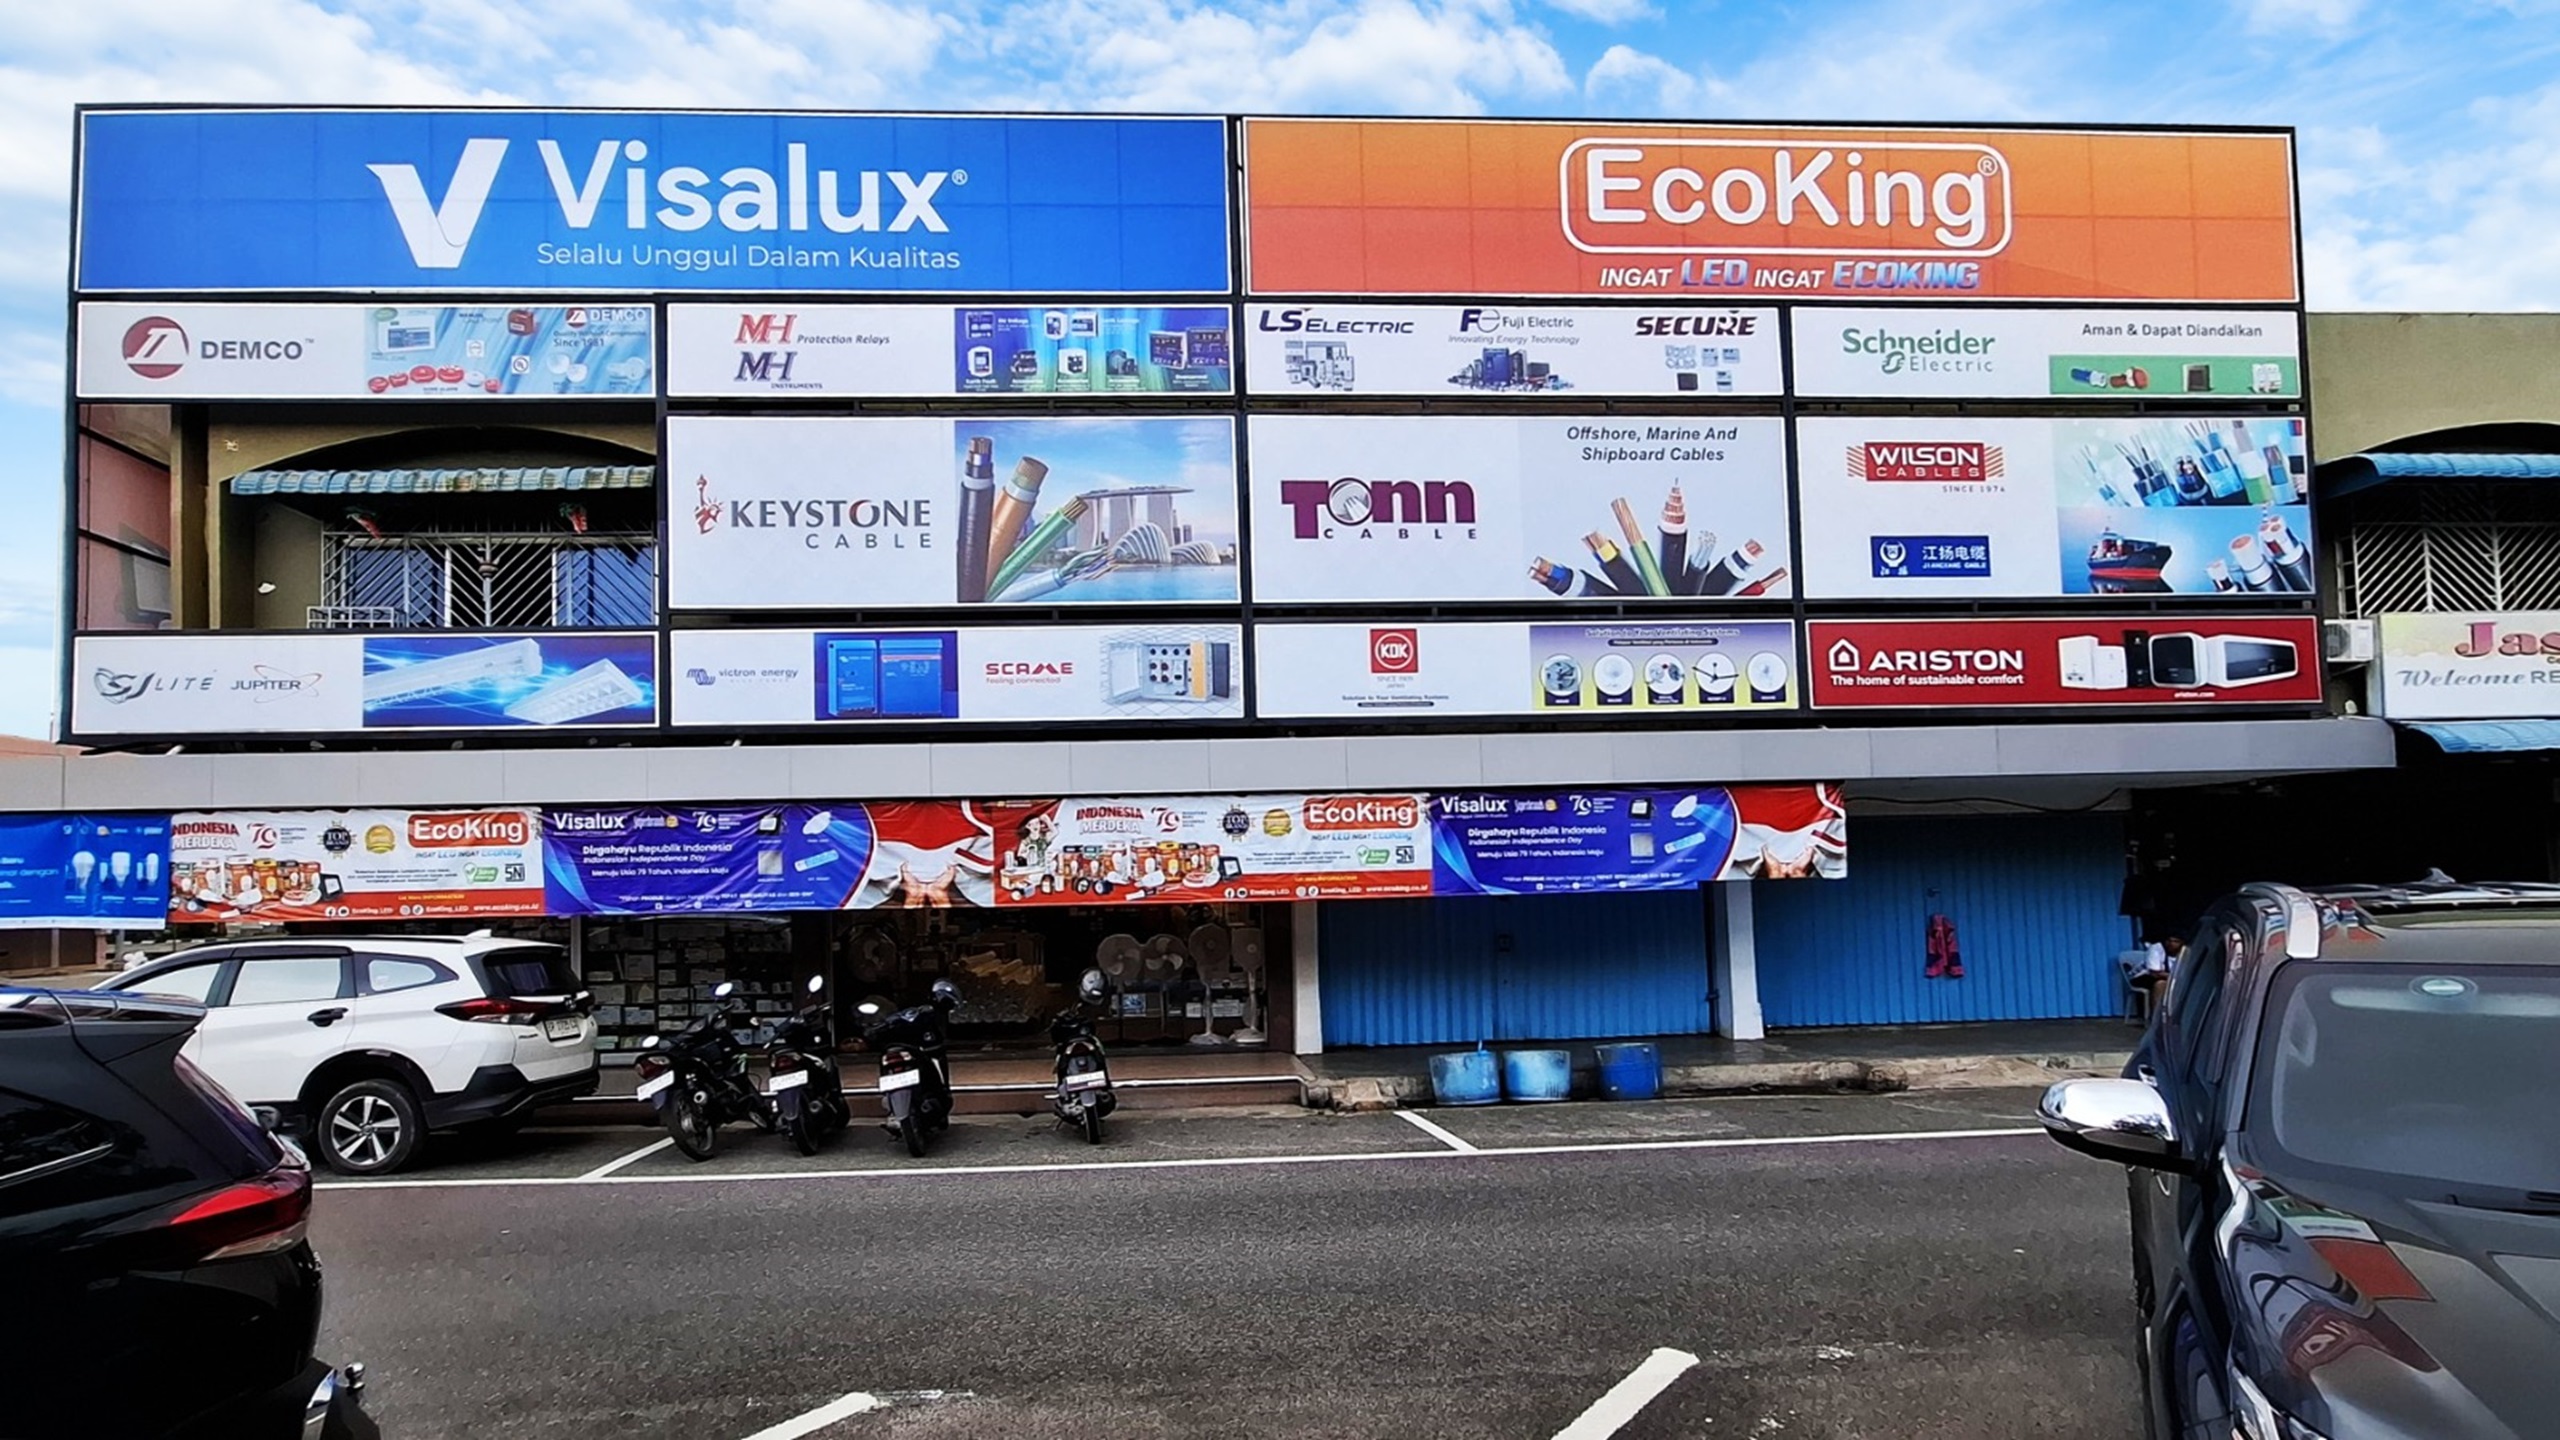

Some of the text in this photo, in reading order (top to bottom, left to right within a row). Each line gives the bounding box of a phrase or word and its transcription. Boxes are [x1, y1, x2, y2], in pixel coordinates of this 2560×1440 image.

[537, 139, 949, 232] Visalux
[1586, 148, 1986, 247] EcoKing
[536, 243, 961, 271] Selalu Unggul Dalam Kualitas
[1600, 258, 1980, 290] INGAT LED INGAT ECOKING
[590, 309, 647, 322] DEMCO
[1259, 310, 1415, 333] LS ELECTRIC
[1502, 316, 1574, 329] Fuji Electric
[1634, 315, 1759, 338] SECURE
[2082, 323, 2263, 341] Aman & Dapat Diandalkan
[553, 338, 580, 347] Since
[797, 334, 890, 346] Protection Relays
[1448, 335, 1581, 346] Innovating Energy Technology
[1842, 327, 1996, 357] Schneider
[201, 340, 303, 360] DEMCO
[1909, 356, 1995, 373] Electric
[1566, 425, 1738, 444] Offshore, Marine And
[1581, 446, 1725, 464] Shipboard Cables
[1869, 446, 1979, 466] WILSON
[1876, 467, 1980, 477] CABLES
[1942, 485, 1975, 493] SINCE
[730, 498, 933, 530] KEYSTONE
[805, 533, 933, 550] CABLE
[1323, 528, 1478, 540] CABLE
[1922, 544, 1987, 561] 江扬电缆
[1380, 643, 1409, 658] KDK
[985, 662, 1074, 675] SCAME
[1868, 649, 2024, 672] ARISTON
[718, 668, 799, 680] victron energy
[1830, 673, 2024, 686] The home of sustainable comfort
[2396, 669, 2527, 687] Welcome
[155, 676, 215, 691] LITE
[230, 679, 302, 691] JUPITER
[1440, 796, 1508, 813] Visalux
[553, 812, 627, 830] Visalux
[1076, 806, 1145, 821] INDONESIA
[1308, 802, 1412, 826] EcoKing
[413, 818, 524, 843] EcoKing
[1079, 819, 1141, 835] MERDEKA
[1468, 825, 1607, 839] Dirgahayu Republik Indonesia
[583, 843, 733, 857] Dirgahayu Republik Indonesia
[1512, 837, 1566, 846] Independence
[630, 855, 688, 865] Independence
